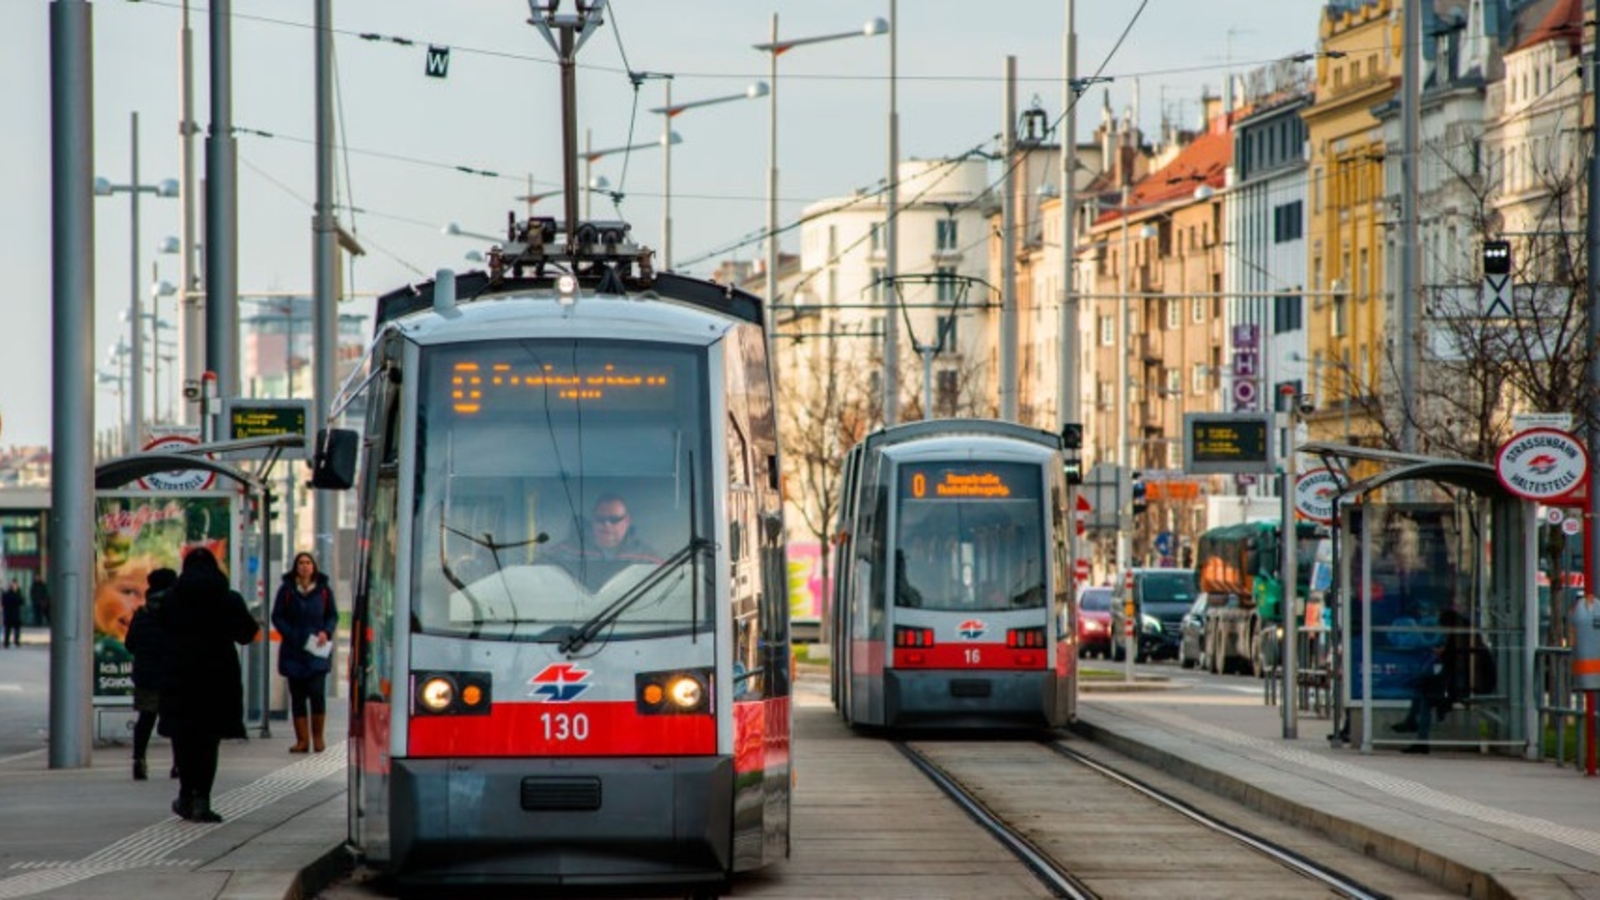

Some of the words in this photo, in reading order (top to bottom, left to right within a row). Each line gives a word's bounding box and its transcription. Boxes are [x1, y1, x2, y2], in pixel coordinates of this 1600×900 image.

[428, 52, 449, 73] W
[1505, 436, 1579, 463] STRASSENBAHN
[1511, 471, 1577, 493] HALTESTELLE
[965, 649, 981, 664] 16
[541, 713, 589, 740] 130
